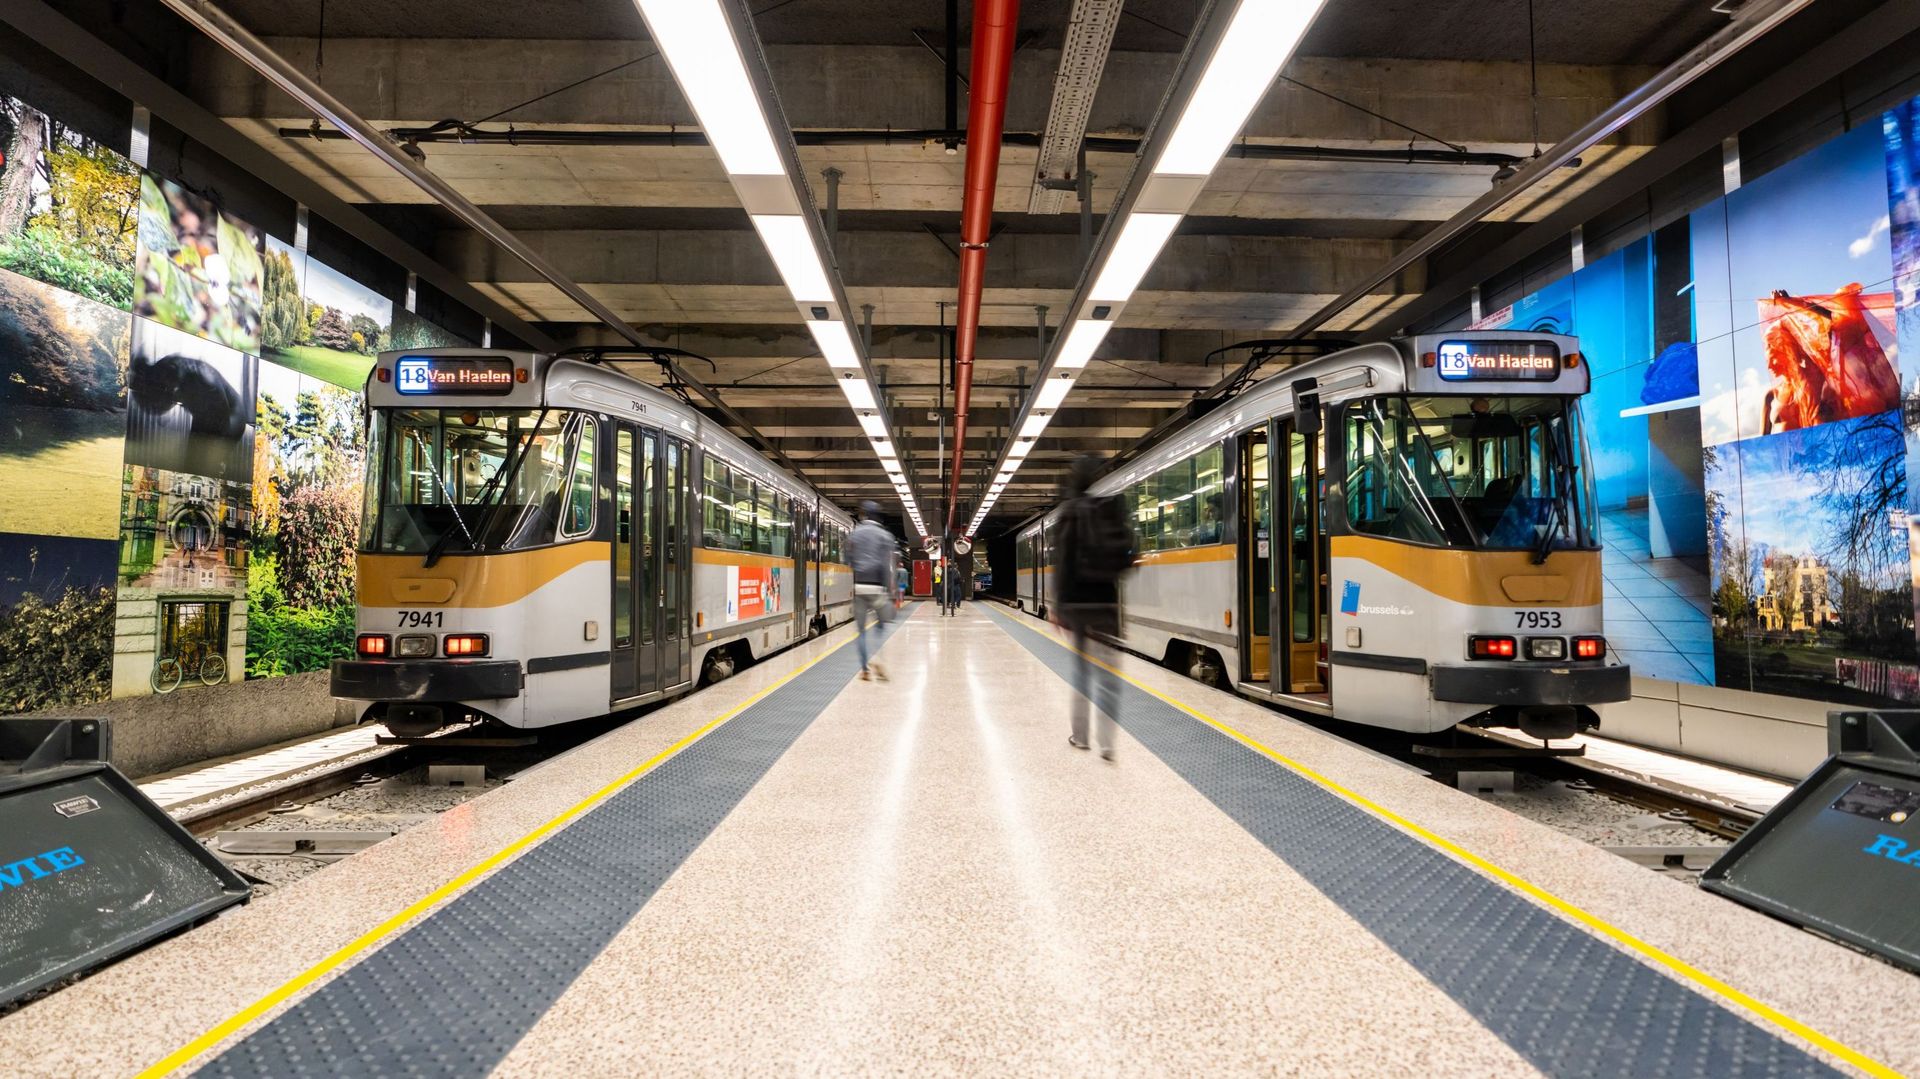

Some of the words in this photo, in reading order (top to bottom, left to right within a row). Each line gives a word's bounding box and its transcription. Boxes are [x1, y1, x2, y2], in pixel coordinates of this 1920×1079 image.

[1441, 352, 1464, 369] 18
[1467, 354, 1496, 368] Van
[1499, 354, 1553, 368] Haelen
[402, 367, 426, 383] 18
[428, 369, 456, 382] Van
[459, 369, 511, 382] Haelen
[631, 400, 647, 414] 7941
[398, 611, 443, 628] 7941
[1514, 611, 1562, 628] 7953
